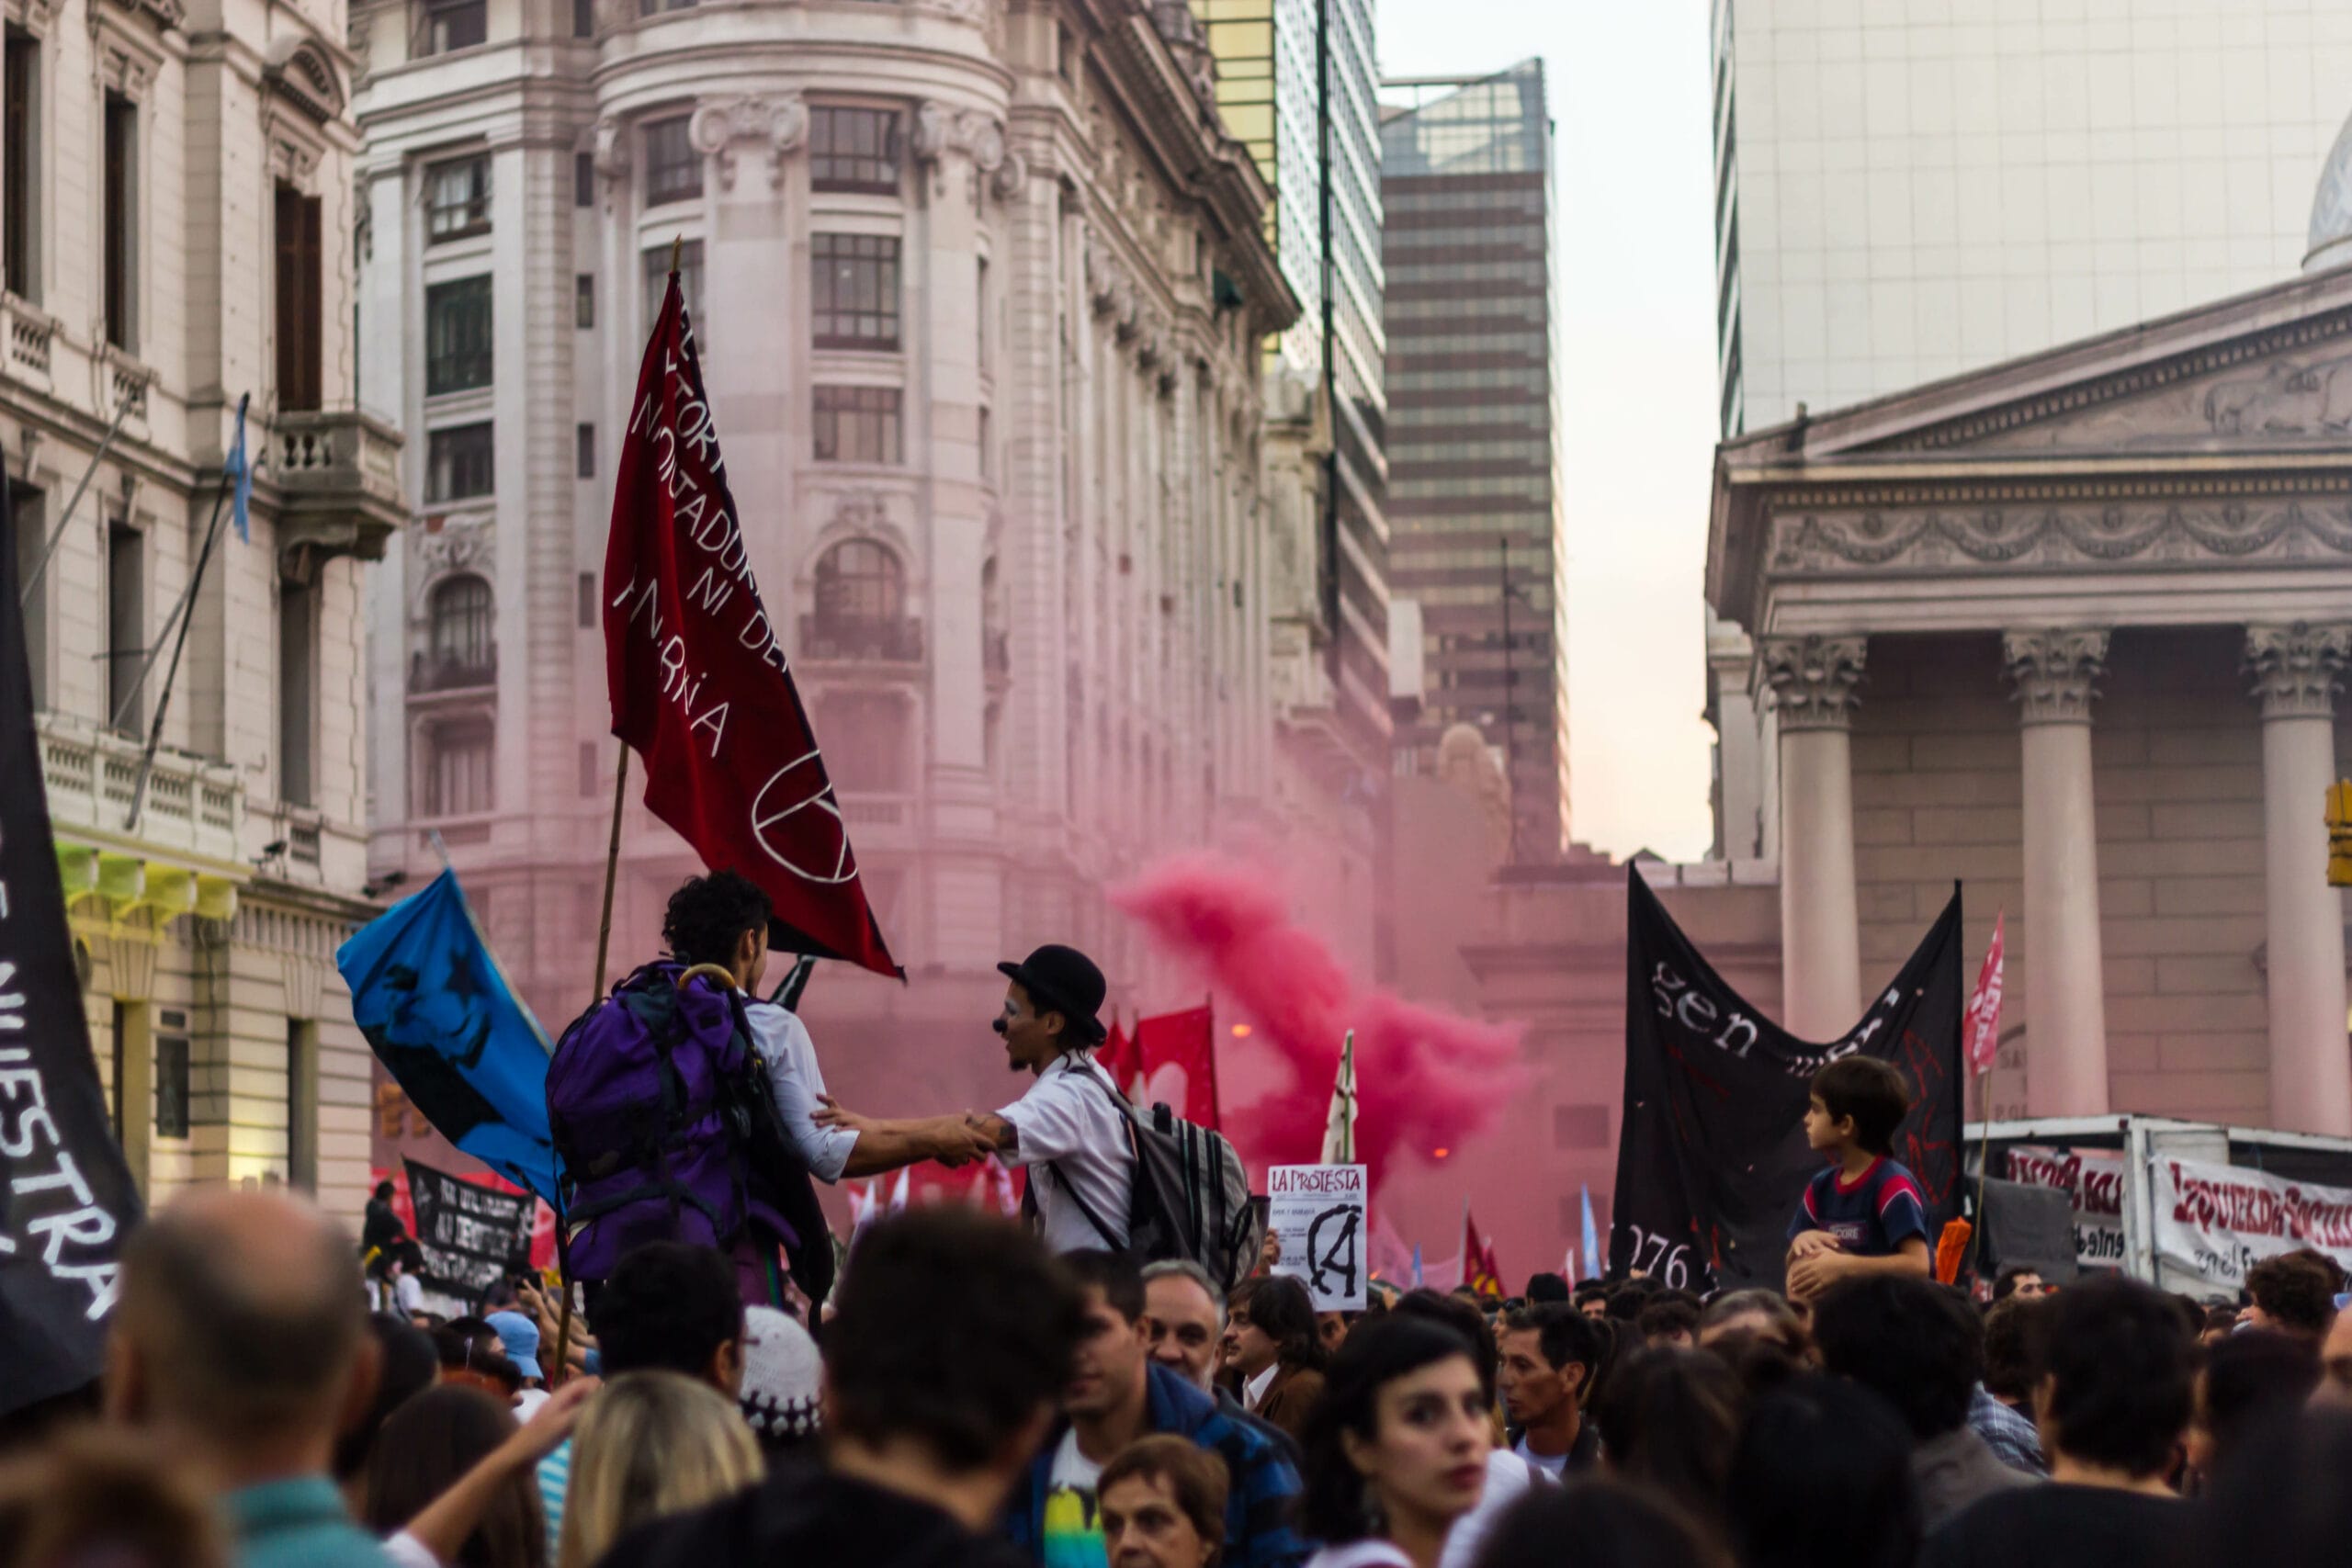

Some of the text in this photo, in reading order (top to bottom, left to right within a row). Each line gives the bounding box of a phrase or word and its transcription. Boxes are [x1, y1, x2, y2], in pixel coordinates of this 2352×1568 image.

[687, 567, 734, 616] NI
[1272, 1168, 1360, 1192] LA PROTESTA
